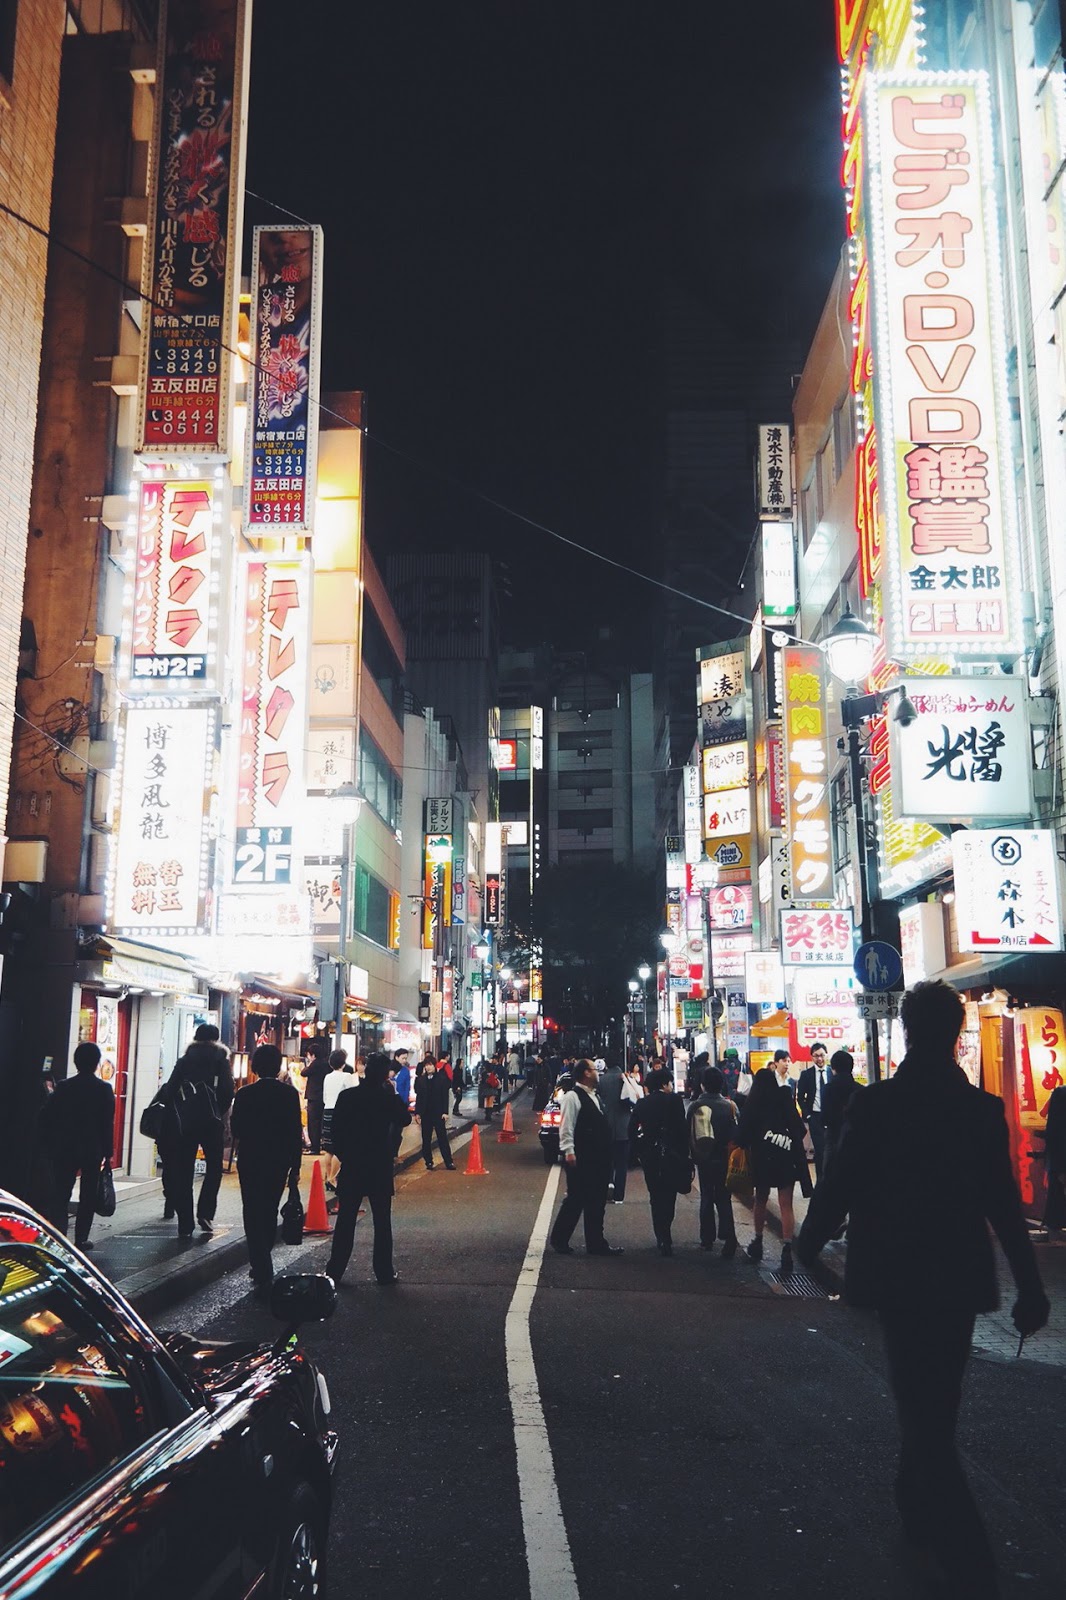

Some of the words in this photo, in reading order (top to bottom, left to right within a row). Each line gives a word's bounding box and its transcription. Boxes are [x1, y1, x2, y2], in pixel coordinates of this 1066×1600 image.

[151, 378, 217, 393] 五反田店
[256, 431, 305, 441] 新宿東口店
[254, 478, 303, 491] 五反田店
[134, 491, 158, 647] リンリンハウス
[166, 491, 211, 648] テレクラ
[909, 565, 1000, 590] 金太郎
[262, 579, 300, 807] テレクラ
[138, 722, 173, 840] 博多風龍
[235, 844, 291, 882] 2F
[720, 848, 737, 857] MINI
[720, 855, 738, 863] STOP
[132, 861, 158, 915] 無料
[158, 860, 184, 912] 替玉
[803, 1027, 844, 1039] 550
[763, 1130, 793, 1151] PINK
